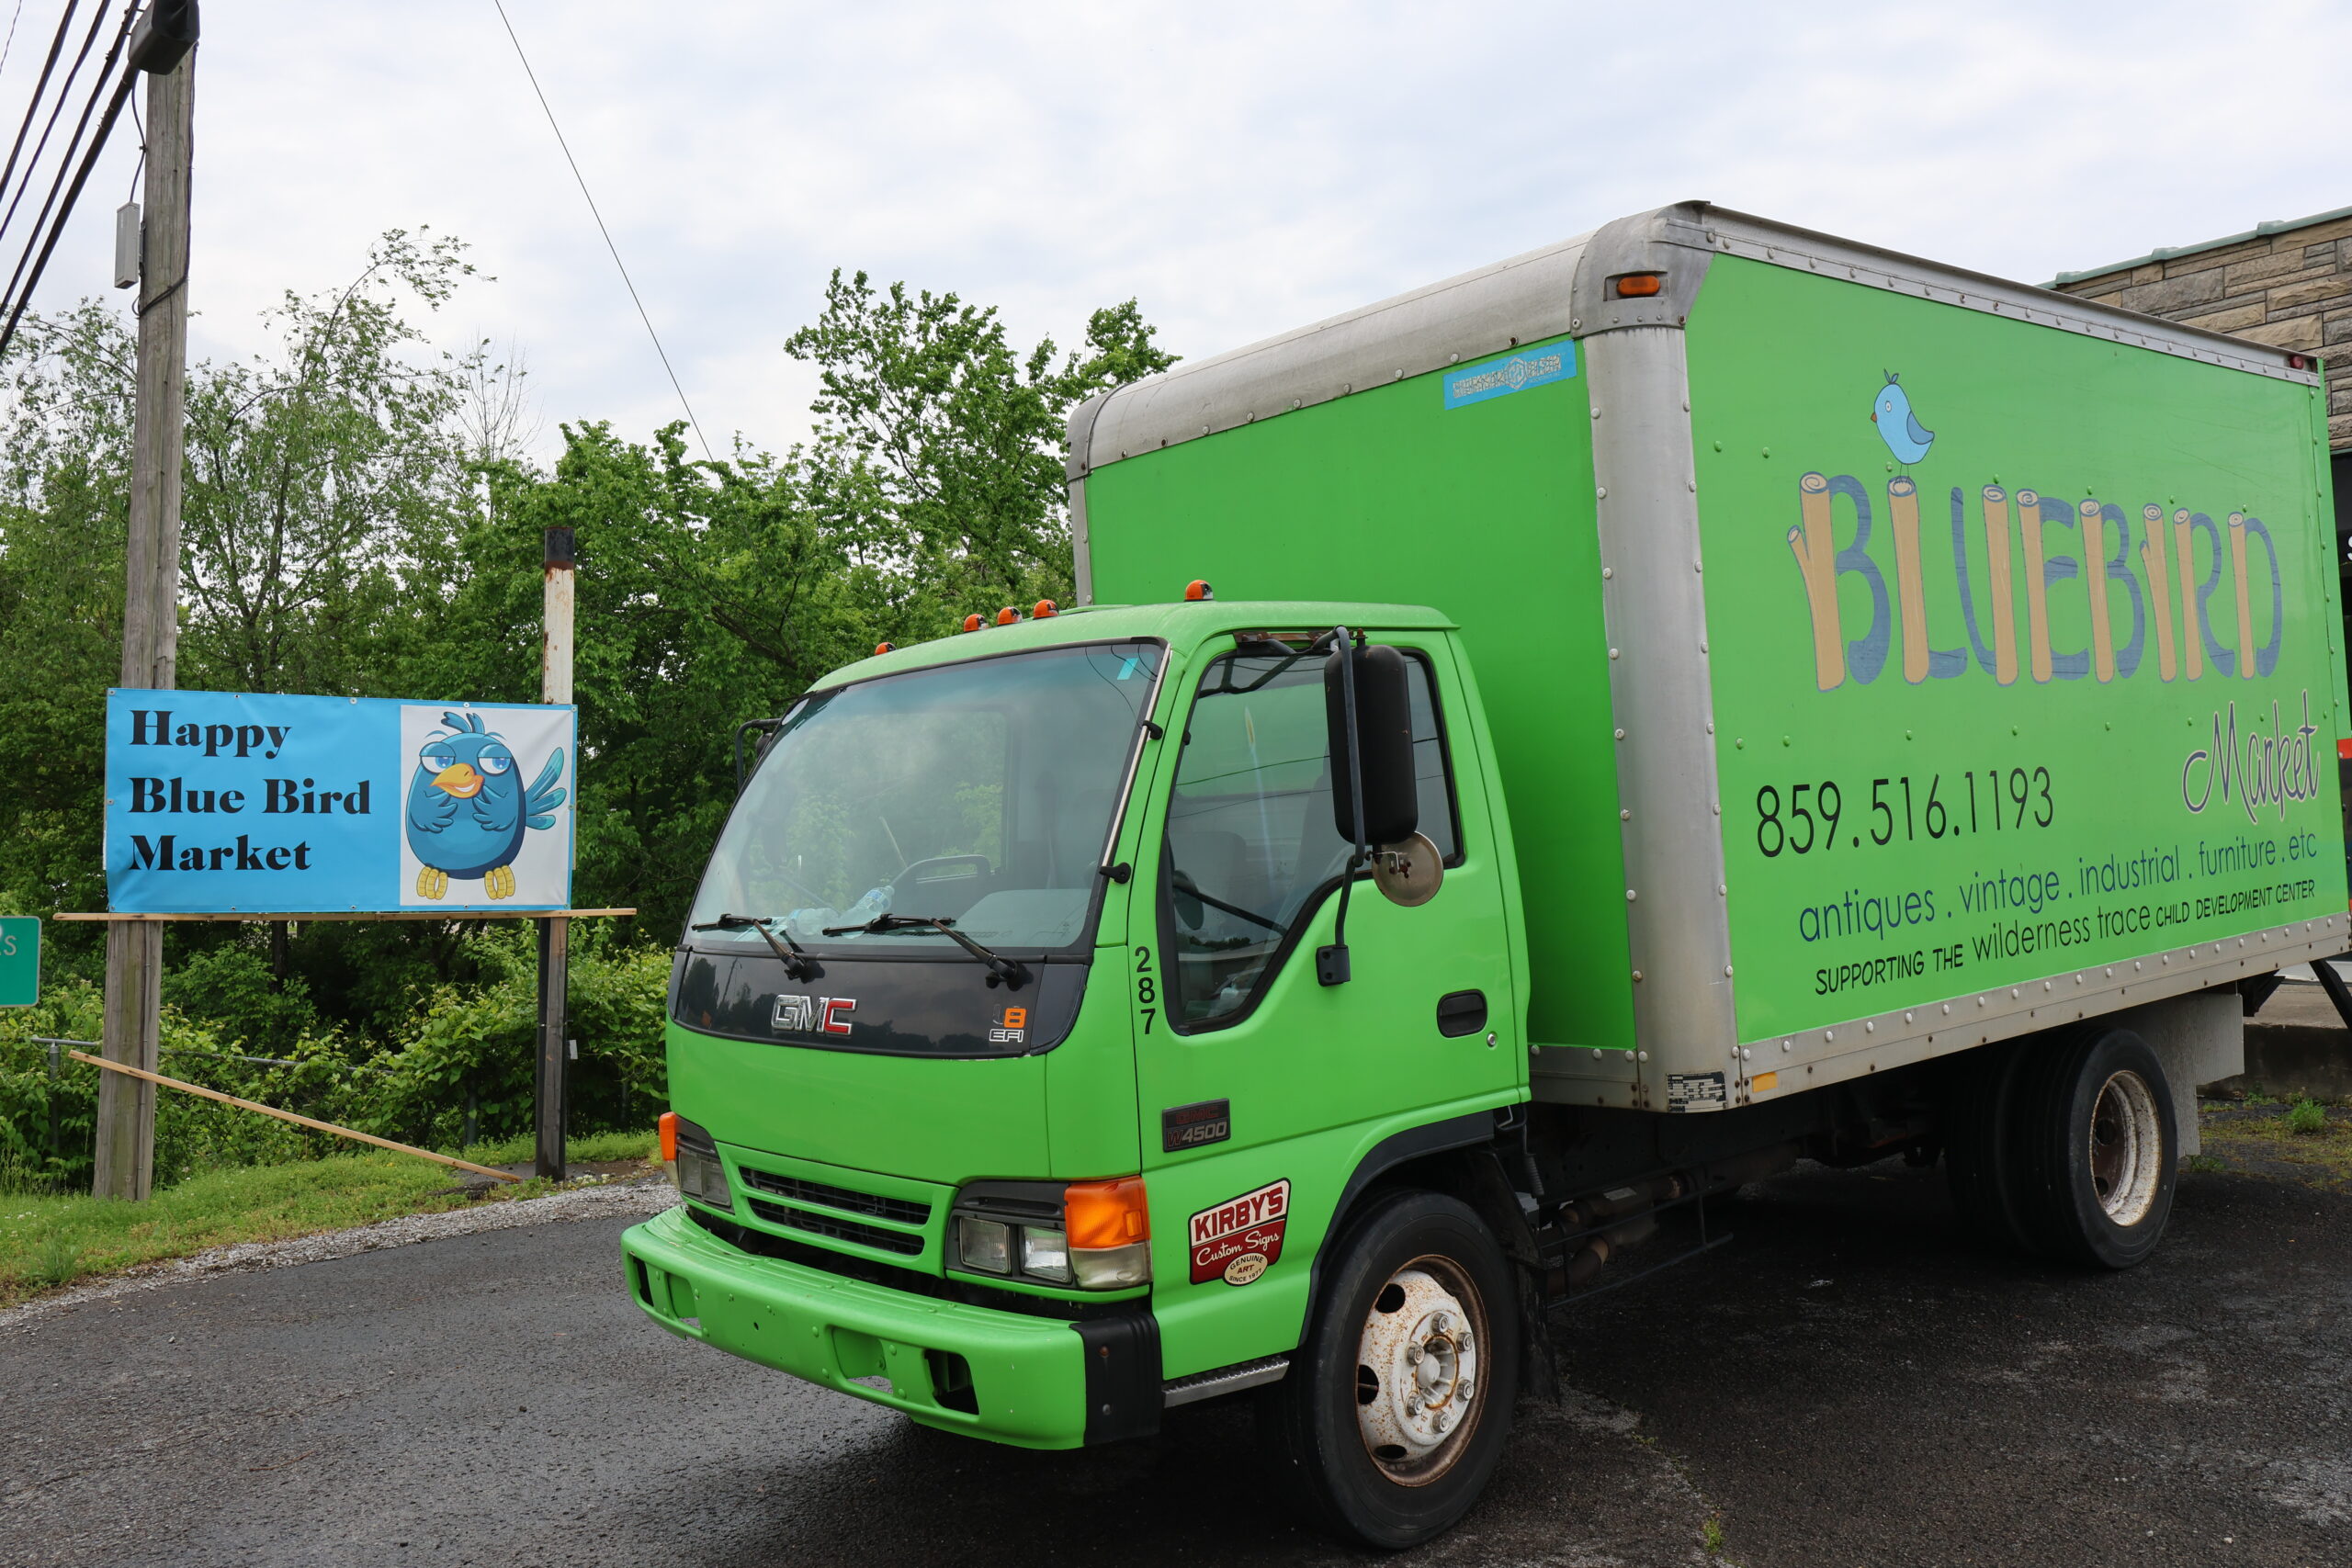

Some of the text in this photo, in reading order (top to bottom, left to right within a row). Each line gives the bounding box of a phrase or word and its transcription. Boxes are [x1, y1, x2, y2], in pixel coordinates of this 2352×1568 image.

[1787, 471, 2282, 693] BLUEBIRD
[128, 710, 292, 760] Happy
[2182, 689, 2321, 825] Market
[127, 776, 371, 815] Blue Bird
[1757, 766, 2053, 857] 859.516.1193
[128, 834, 312, 871] Market
[1800, 888, 1935, 942] antiques
[1959, 868, 2060, 914] vintage
[2078, 844, 2180, 896] industrial
[1815, 879, 2315, 995] SUPPORTING THE wilderness trace CHILD DEVELOPMENT CENTER
[771, 994, 857, 1035] GMC
[1167, 1121, 1227, 1147] W4500
[1194, 1186, 1283, 1242] KIRBY'S
[1196, 1230, 1280, 1266] Custom Signs
[1229, 1255, 1264, 1270] GENUINE
[1237, 1264, 1255, 1274] ART
